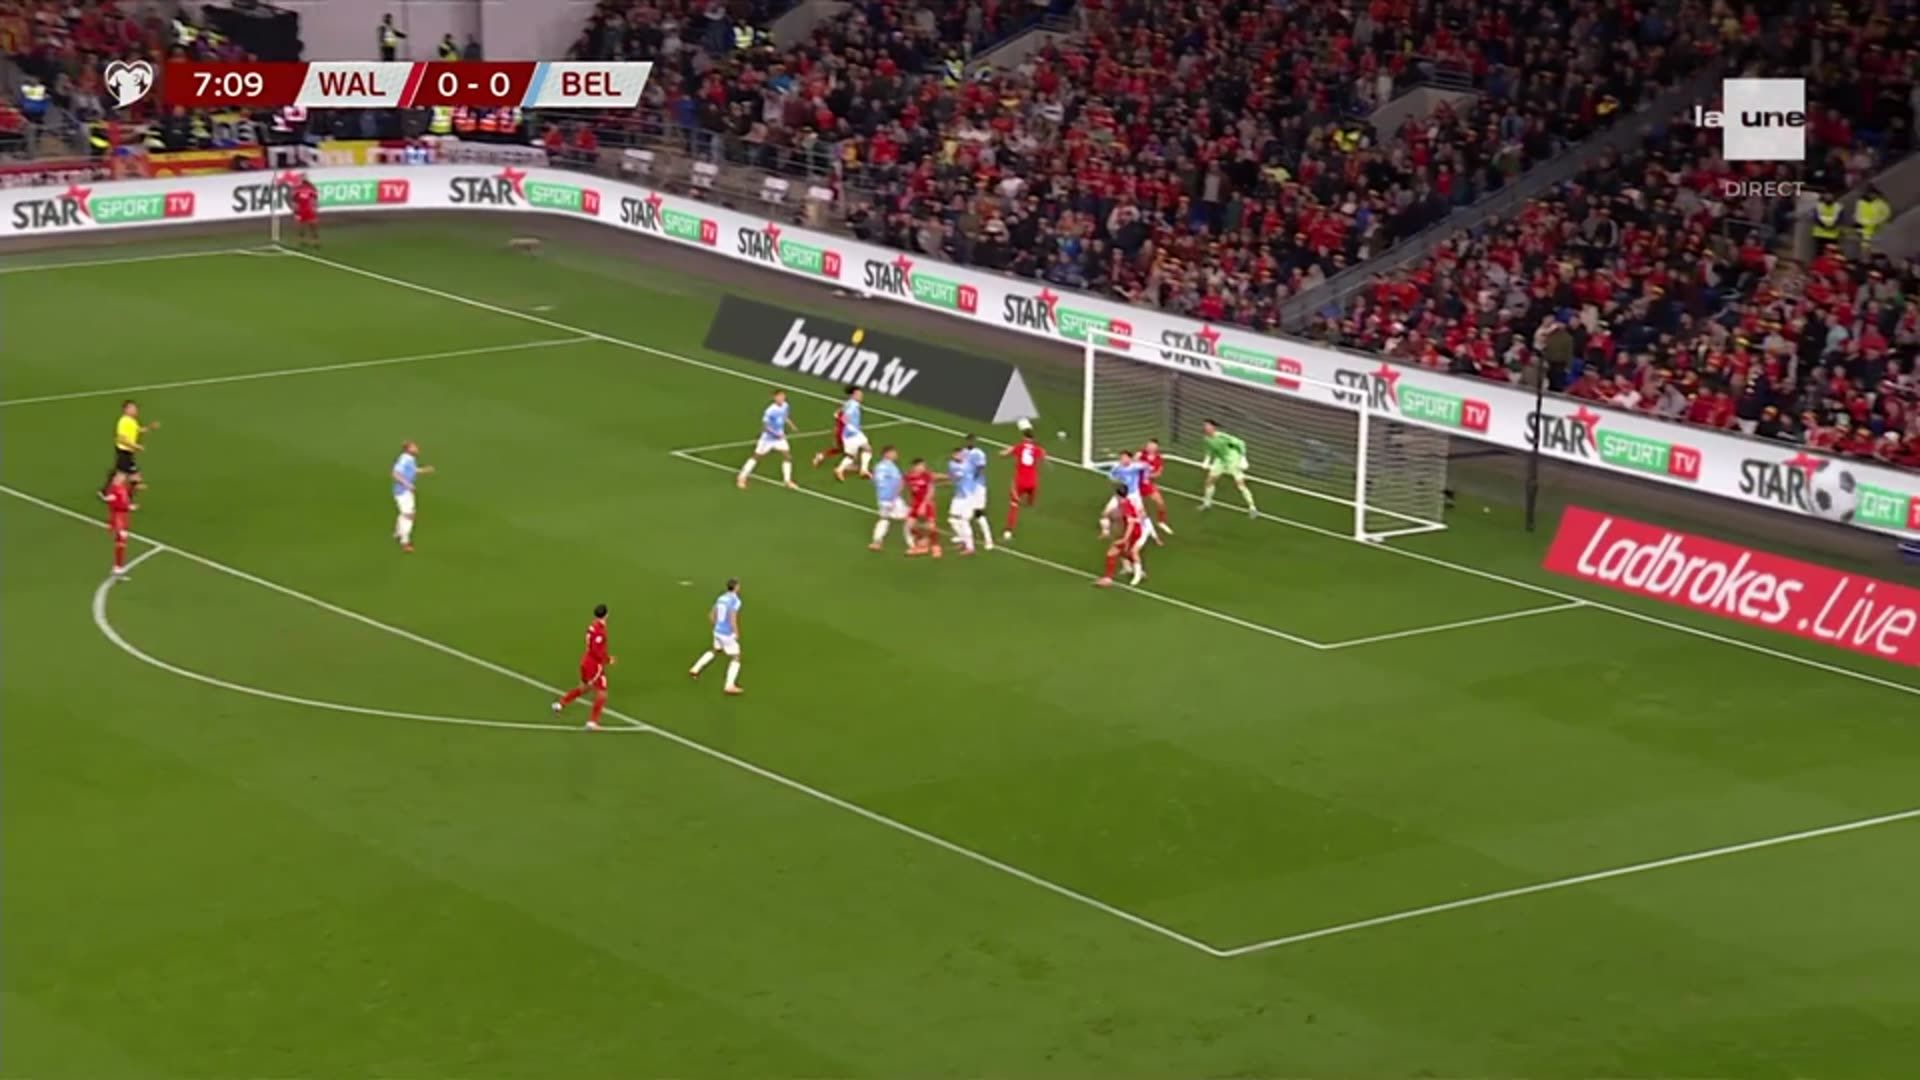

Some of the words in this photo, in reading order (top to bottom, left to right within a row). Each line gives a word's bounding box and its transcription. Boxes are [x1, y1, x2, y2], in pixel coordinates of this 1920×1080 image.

[12, 198, 83, 229] STAR
[97, 194, 162, 219] SPORT
[168, 196, 191, 213] TV
[232, 183, 294, 213] STAR
[321, 181, 373, 200] PORT
[381, 183, 406, 199] TV
[449, 176, 516, 205] STAR
[531, 184, 581, 209] SPORT
[584, 192, 599, 211] TV
[620, 196, 658, 230] STAR
[665, 212, 699, 240] SPORT
[702, 222, 716, 242] TV
[738, 227, 775, 262] STAR
[782, 243, 821, 271] SPORT
[824, 255, 839, 272] TV
[864, 259, 906, 296] STAR
[914, 277, 957, 307] SPORT
[960, 288, 976, 309] TV
[1003, 294, 1050, 331] STAR
[771, 318, 919, 396] bwin.tv
[1332, 369, 1390, 411] STAR
[1403, 391, 1460, 422] SPORT
[1465, 404, 1487, 426] TV
[1524, 412, 1590, 459] STAR
[1603, 435, 1667, 467] SPORT
[1673, 451, 1697, 474] TV
[1738, 458, 1808, 511] STAR
[1862, 491, 1905, 522] ORT
